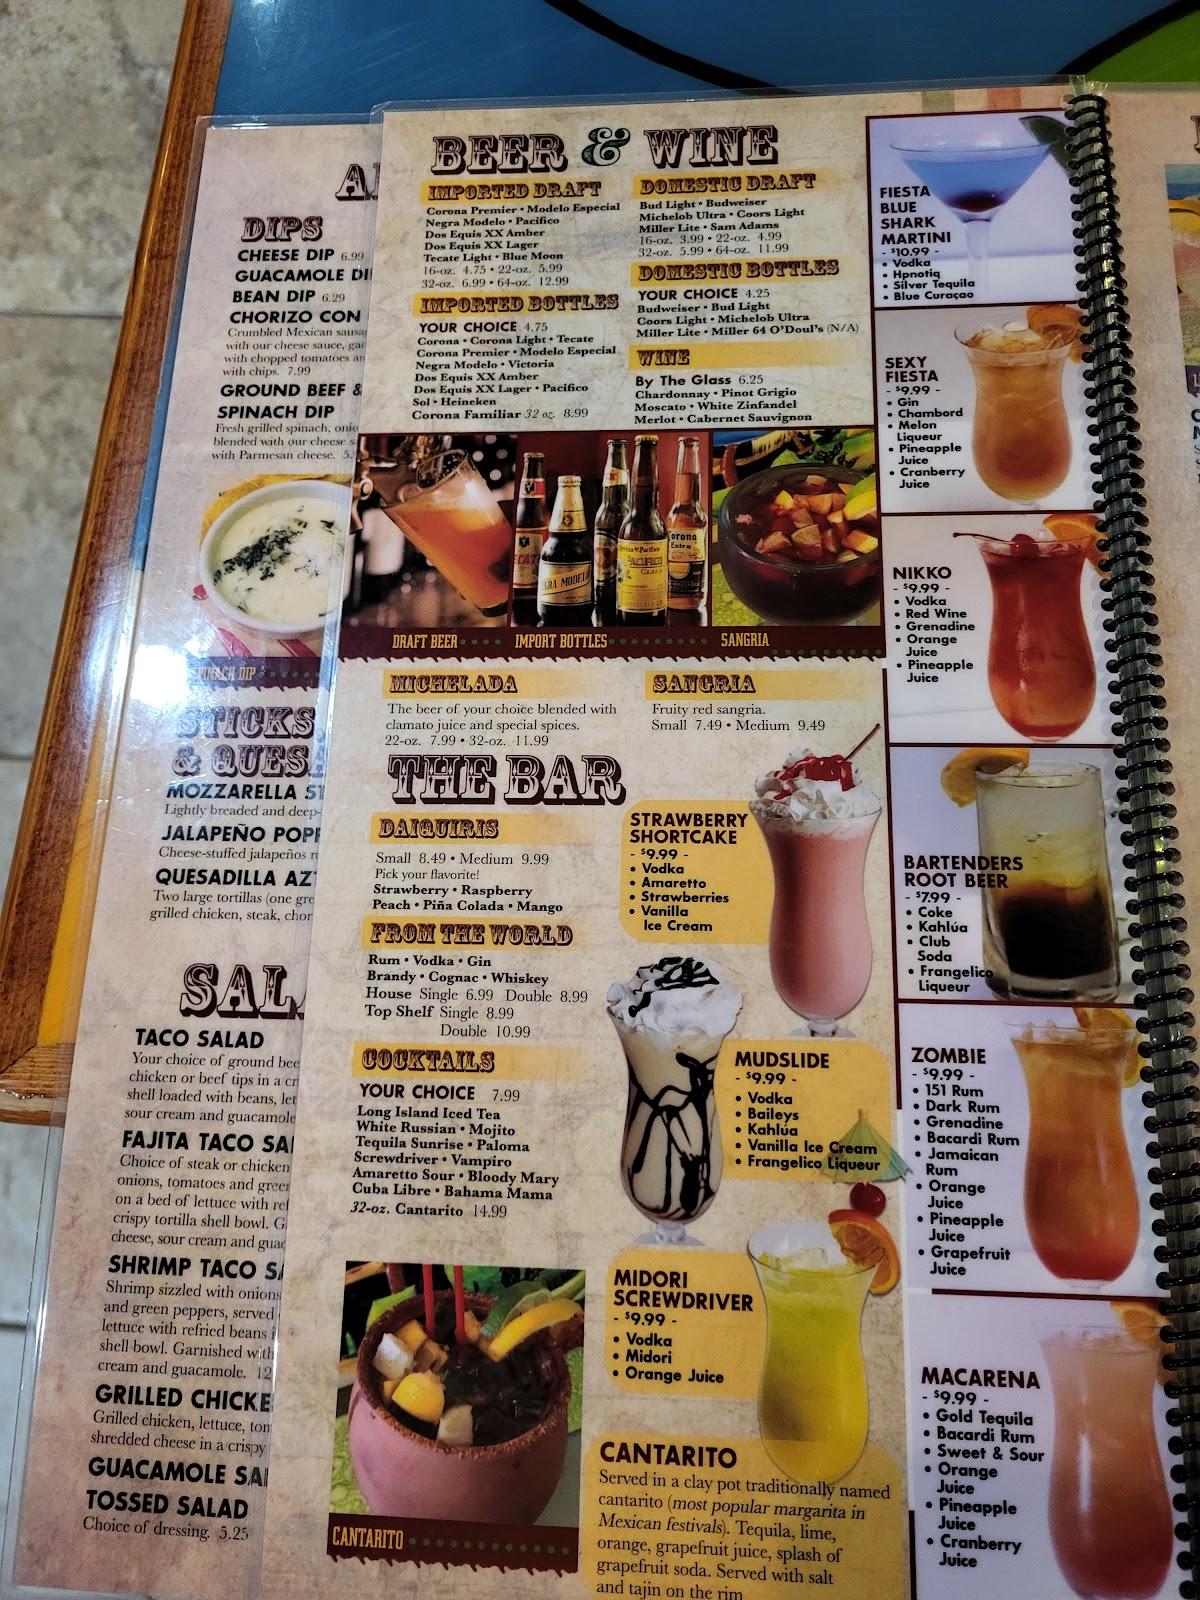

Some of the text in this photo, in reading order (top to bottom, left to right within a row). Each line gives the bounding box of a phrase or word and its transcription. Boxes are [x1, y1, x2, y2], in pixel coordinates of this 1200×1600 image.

[431, 125, 778, 176] BEER & WINE
[428, 181, 602, 201] IMPORTED DRAFT
[640, 173, 816, 195] DOMESTIC DRAFT
[880, 185, 931, 198] FIESTA
[426, 202, 620, 215] Corona Premier Modelo Especial
[880, 201, 916, 214] BLUE
[241, 216, 323, 243] DIPS
[881, 216, 936, 229] SHARK
[640, 232, 782, 245] 16-oz. 3.99 22-oz. 4.99
[881, 231, 951, 245] MARTINI
[238, 248, 364, 262] CHEESE DIP 6.99
[638, 259, 839, 281] DOMESTIC BOTTLES
[893, 278, 975, 290] Silver Tequila
[232, 290, 345, 303] BEAN DIP 6.29
[638, 288, 770, 301] YOUR CHOICE 4.25
[637, 349, 690, 366] WINE
[885, 356, 927, 369] SEXY
[223, 366, 311, 379] with chips. 7.99
[886, 370, 939, 383] FIESTA
[636, 374, 764, 389] By The Glass 6.25
[217, 405, 335, 419] SPINACH DIP
[412, 408, 588, 420] Corona Familiar 32 oz. 8.99
[898, 407, 963, 418] Chambord
[893, 566, 952, 579] NIKKO
[906, 621, 975, 631] Grenadine
[392, 634, 458, 648] DRAFT BEER
[515, 634, 607, 648] IMPORT BOTTLES
[721, 633, 770, 647] SANGRIA
[238, 666, 256, 681] DIP
[390, 675, 518, 693] MICHELADA
[653, 674, 756, 693] SANGRIA
[653, 703, 765, 718] Fruity red sangria.
[179, 706, 316, 740] STICKS
[385, 735, 549, 746] 22-oz. 7.99 32-oz. 11.99
[387, 754, 626, 806] THE BAR
[166, 784, 297, 800] MOZZARELLA
[165, 803, 285, 818] Lightly breaded and
[379, 818, 499, 839] DAIQUIRIS
[630, 813, 748, 827] STRAWBERRY
[161, 823, 266, 842] JALAPEÑO
[630, 829, 737, 844] SHORTCAKE
[904, 853, 1023, 871] BARTENDERS
[155, 868, 276, 886] QUESADILLA
[641, 877, 706, 888] Amaretto
[904, 872, 1009, 889] ROOT BEER
[373, 883, 532, 899] Strawberry Raspberry
[370, 923, 573, 946] FROM THE WORLD
[919, 920, 968, 933] Kahlúa
[364, 1004, 514, 1022] Top Shelf Single 8.99
[136, 1028, 264, 1049] TACO SALAD
[362, 1048, 495, 1073] COCKTAILS
[735, 1051, 829, 1069] MUDSLIDE
[911, 1047, 986, 1064] ZOMBIE
[360, 1083, 520, 1102] YOUR CHOICE 7.99
[925, 1083, 984, 1097] 151 Rum
[357, 1105, 501, 1121] Long Island Iced Tea
[748, 1123, 798, 1136] Kahlúa
[122, 1130, 254, 1152] FAJITA TACO
[120, 1154, 290, 1173] Choice of steak or chicken
[748, 1154, 880, 1173] Frangelico Liqueur
[350, 1201, 507, 1218] 32-oz. Cantarito 14.99
[931, 1245, 1011, 1262] Grapefruit
[108, 1255, 256, 1280] SHRIMP TACO
[614, 1269, 687, 1289] MIDORI
[613, 1289, 753, 1312] SCREWDRIVER
[625, 1366, 724, 1384] Orange Juice
[921, 1367, 1040, 1389] MACARENA
[95, 1384, 183, 1407] GRILLED
[936, 1408, 1033, 1428] Gold Tequila
[600, 1441, 737, 1469] CANTARITO
[88, 1456, 226, 1484] GUACAMOLE
[599, 1469, 890, 1501] Served in a clay pot traditionally named
[86, 1489, 248, 1519] TOSSED SALAD
[83, 1516, 249, 1542] Choice of dressing. 5.25
[333, 1526, 403, 1550] CANTARITO
[940, 1533, 1022, 1557] Cranberry
